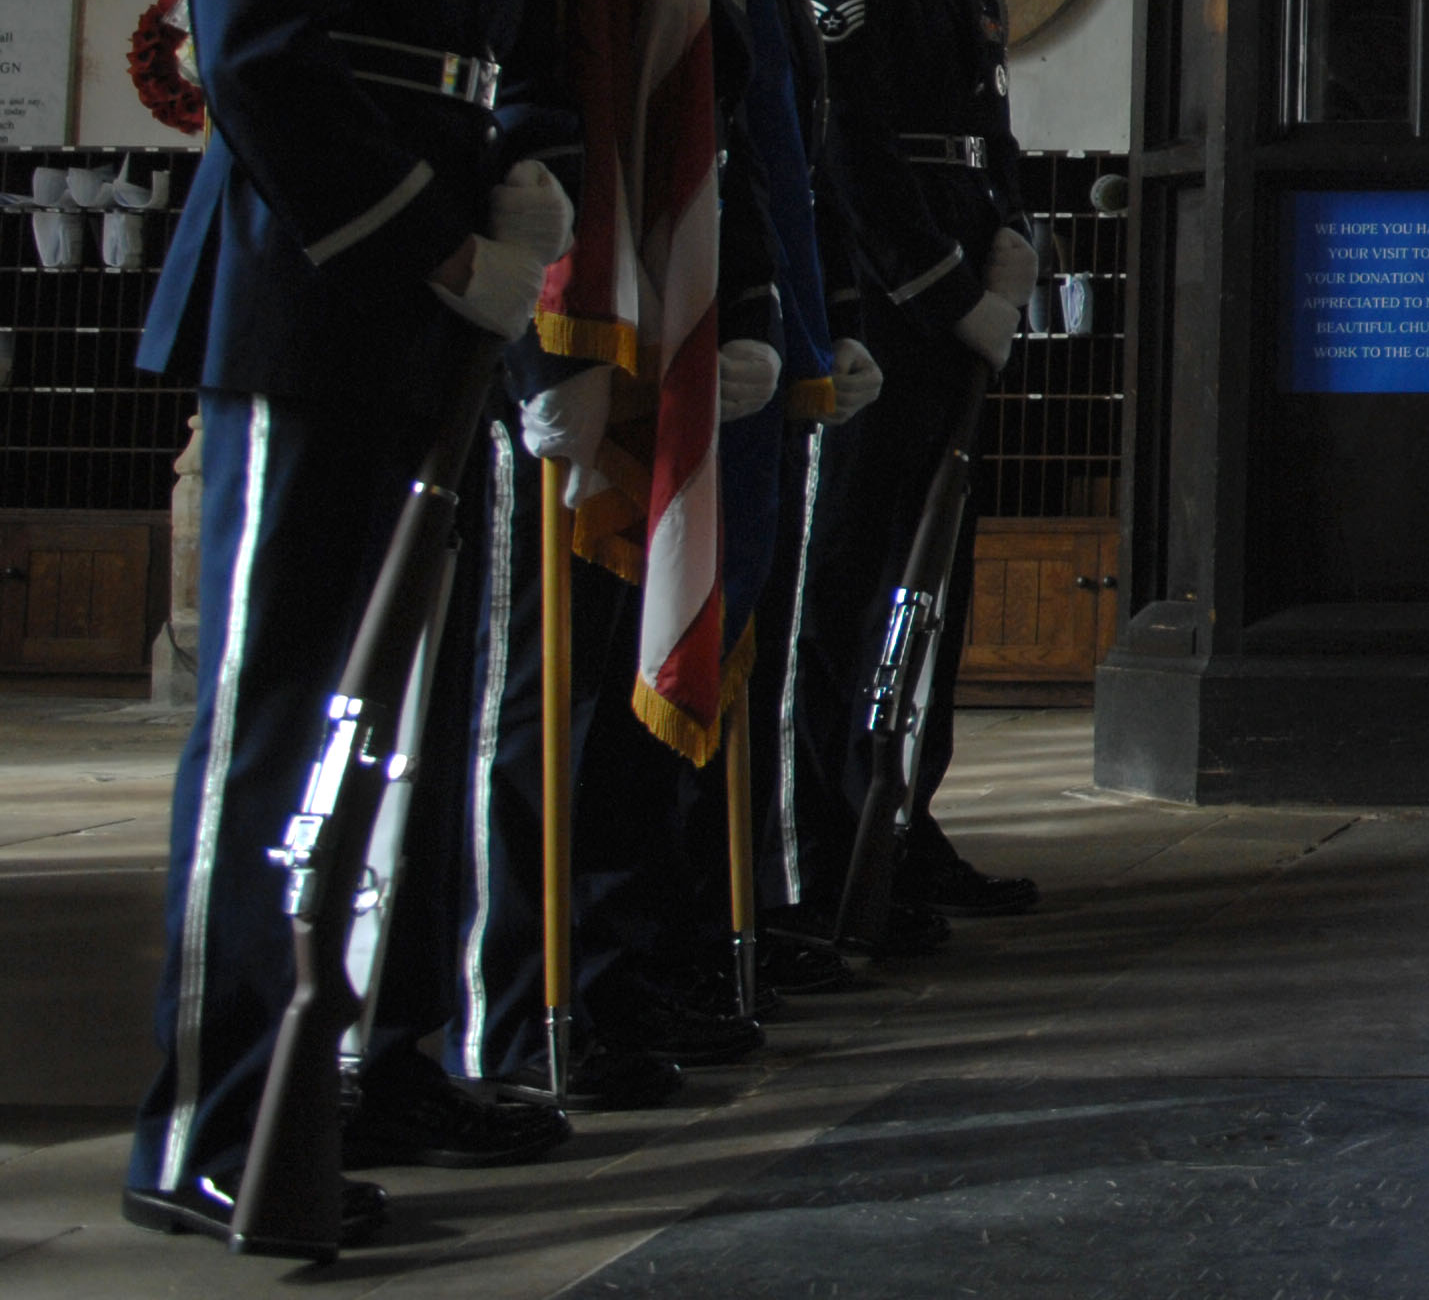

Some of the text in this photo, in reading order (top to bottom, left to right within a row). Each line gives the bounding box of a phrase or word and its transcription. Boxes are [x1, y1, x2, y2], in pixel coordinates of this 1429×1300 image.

[1315, 223, 1338, 236] WE
[1341, 223, 1378, 236] HOPE
[1382, 223, 1412, 236] YOU
[1329, 248, 1368, 260] YOUR
[1372, 248, 1408, 260] VISIT
[1305, 272, 1345, 285] YOUR
[1349, 272, 1424, 285] DONATION
[1303, 297, 1399, 309] APPRECIATED
[1403, 297, 1423, 309] TO
[1317, 321, 1396, 334] BEAUTIFUL
[1314, 346, 1357, 359] WORK
[1362, 346, 1380, 359] TO
[1385, 346, 1412, 359] THE
